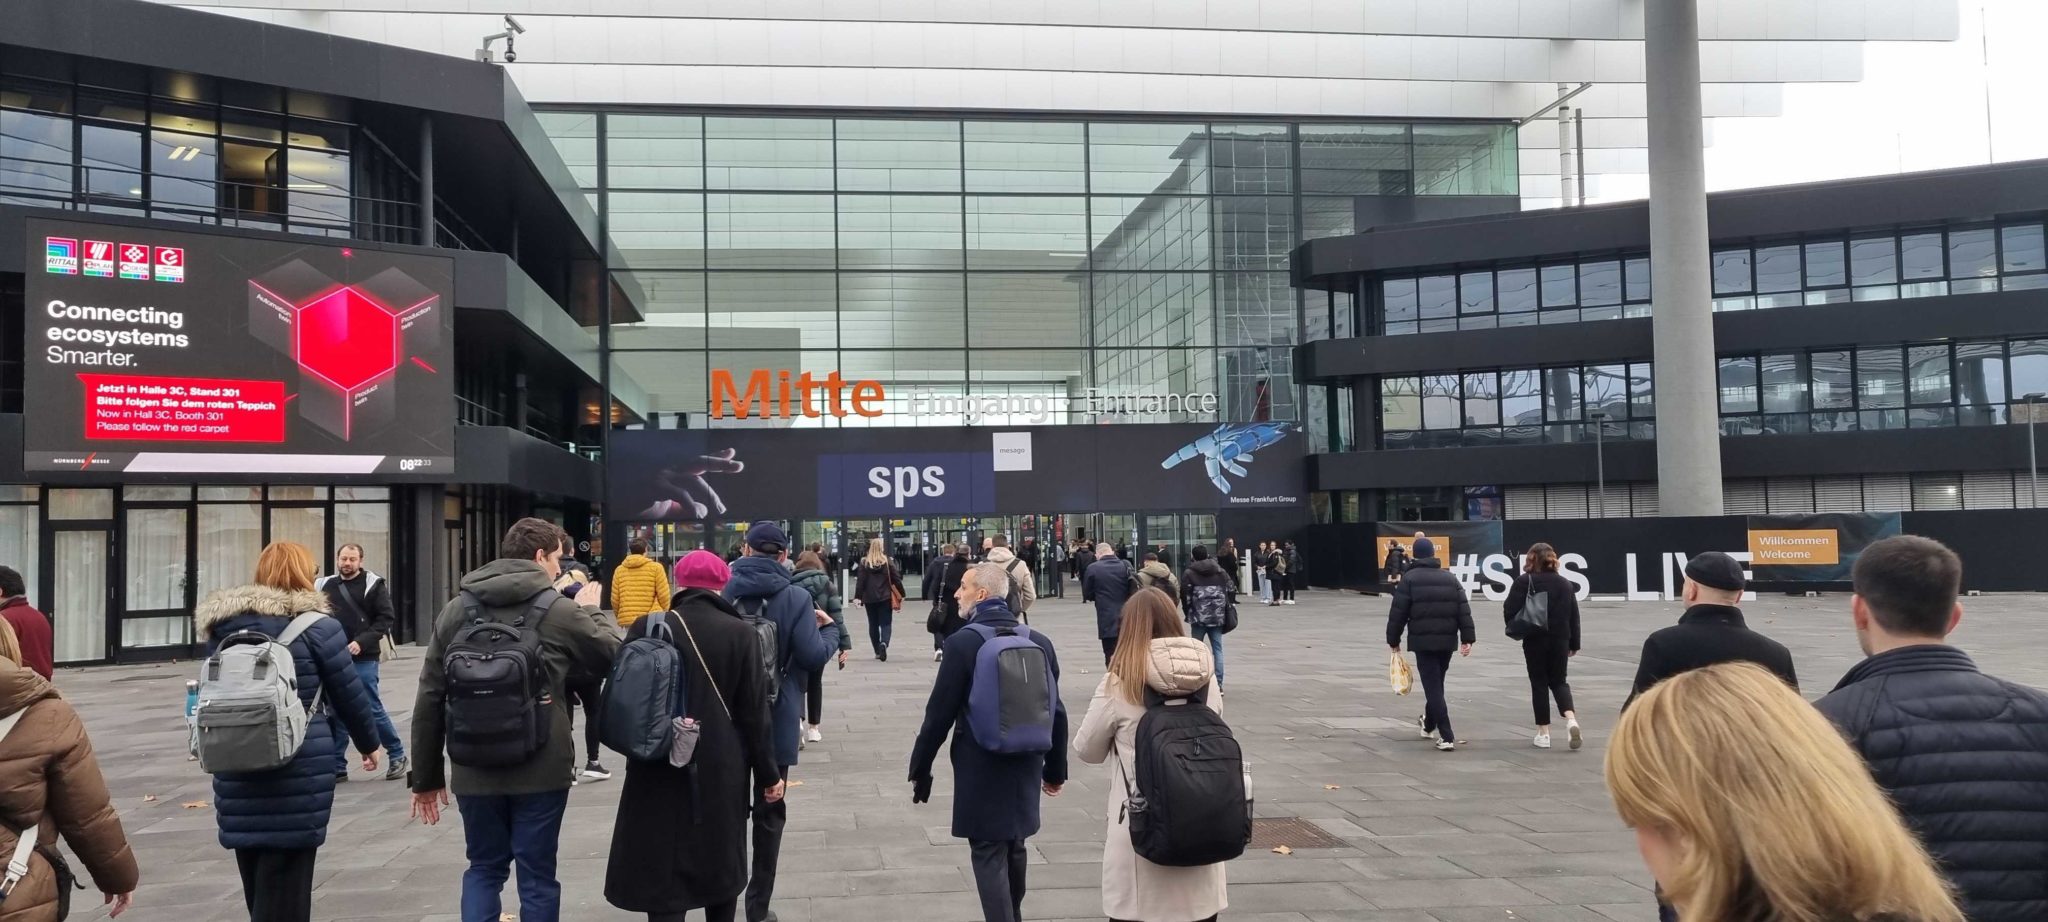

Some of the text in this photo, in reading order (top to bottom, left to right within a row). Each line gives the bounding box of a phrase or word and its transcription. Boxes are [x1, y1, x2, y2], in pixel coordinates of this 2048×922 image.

[48, 257, 77, 266] RITTAL
[256, 293, 292, 318] Automation
[47, 300, 183, 329] Connecting
[278, 313, 292, 325] twin
[401, 306, 431, 324] Production
[401, 321, 414, 331] twin
[47, 326, 189, 347] ecosystems
[47, 345, 138, 367] Smarter.
[97, 384, 240, 397] Jetzt in Halle 3C, Stand 301
[354, 384, 378, 399] Product
[710, 369, 1217, 424] Mitte Eingang Entrance
[97, 397, 276, 411] Bitte folgen Sie dem roten Teppich
[354, 396, 368, 407] twin
[97, 409, 120, 418] Now
[123, 410, 131, 418] in
[134, 410, 153, 418] Hall
[176, 411, 204, 420] Booth
[206, 412, 224, 420] 301
[97, 421, 229, 434] Please follow the red carpet
[868, 465, 945, 508] sps
[1250, 495, 1278, 503] Frankfurt
[1278, 495, 1297, 503] Group
[1759, 536, 1829, 545] Willkommen
[1759, 550, 1811, 559] Welcome
